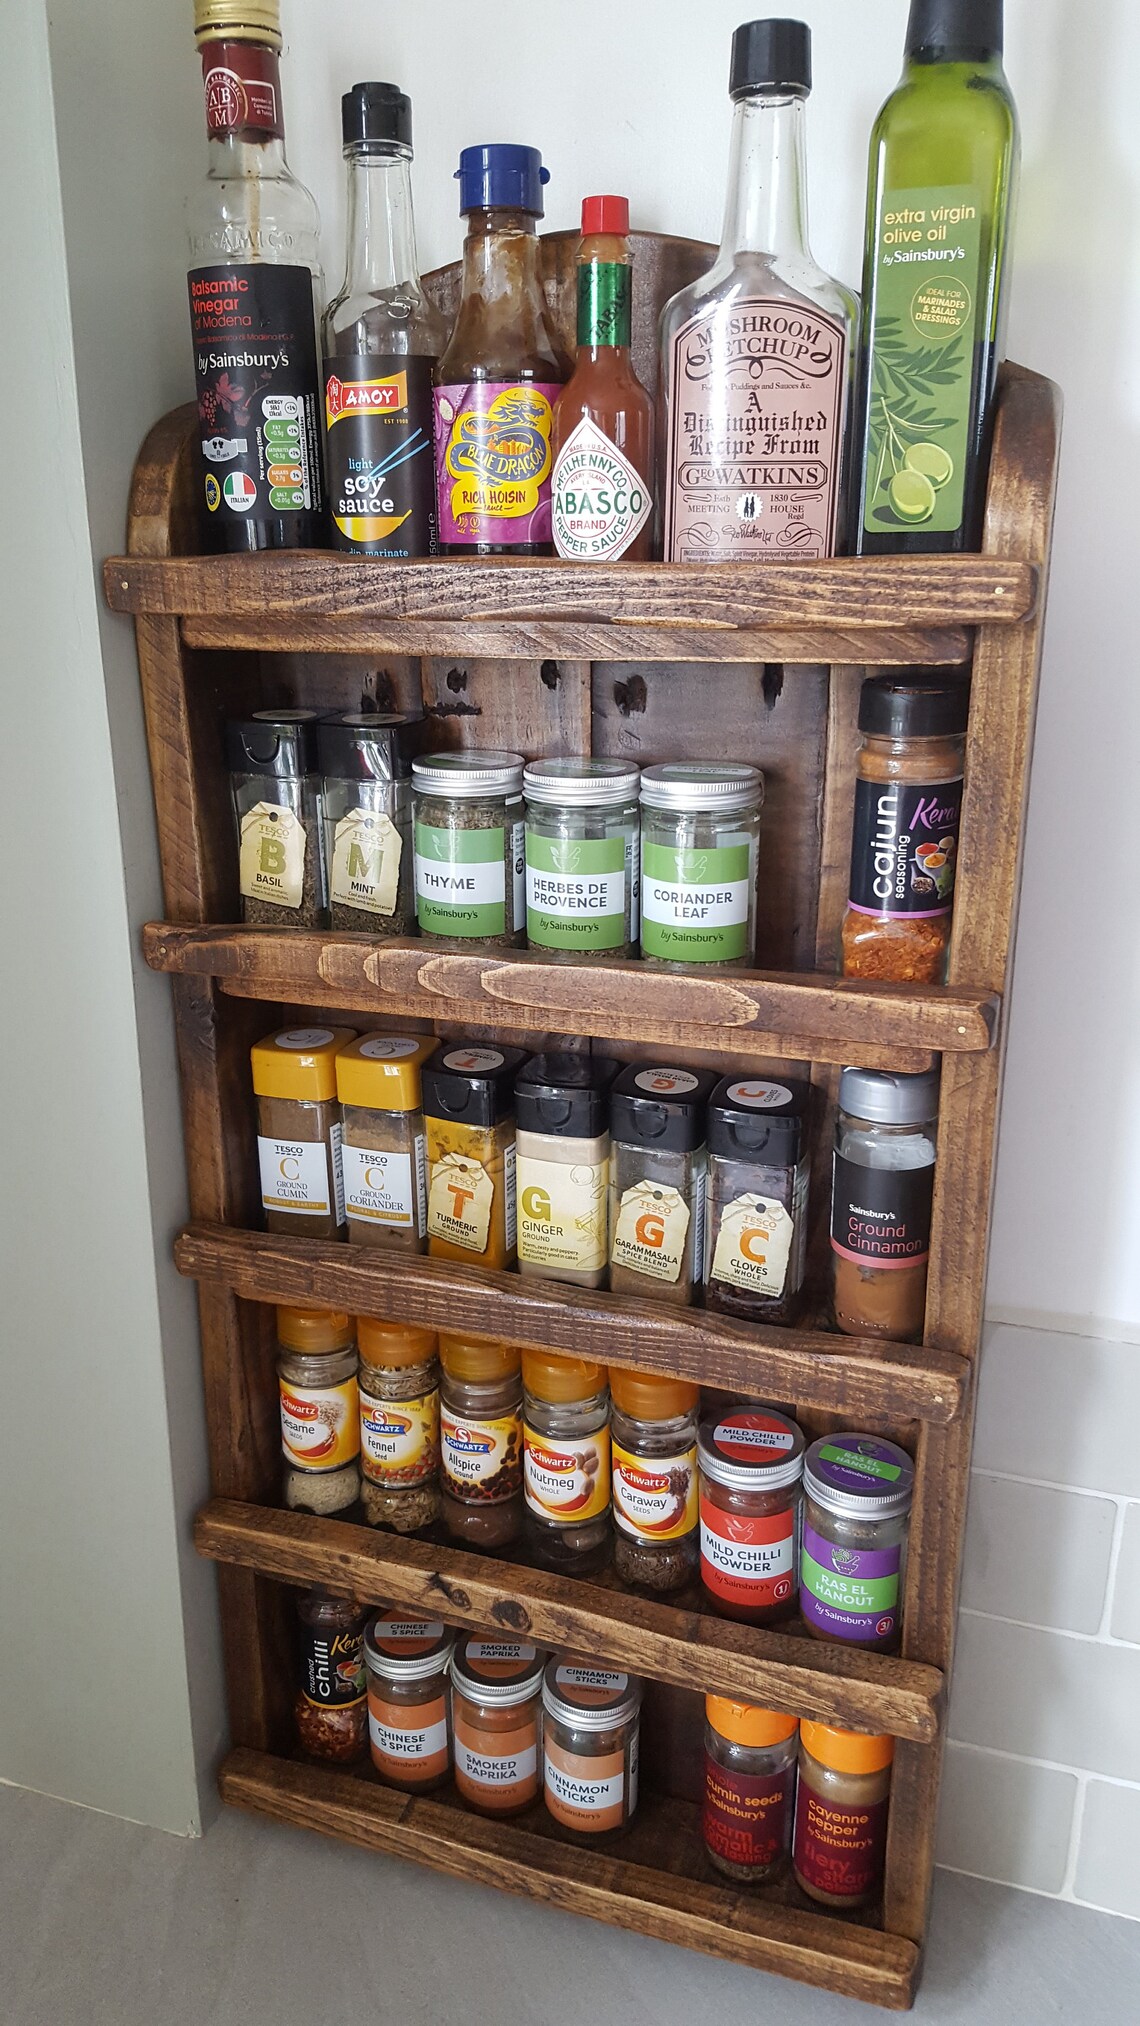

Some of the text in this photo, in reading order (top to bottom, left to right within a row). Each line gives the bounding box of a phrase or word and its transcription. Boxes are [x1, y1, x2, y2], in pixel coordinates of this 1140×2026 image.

[885, 204, 976, 225] extra virgin
[883, 225, 947, 245] olive oil
[883, 246, 966, 267] by Sainsbury's
[191, 276, 249, 297] Balsamic
[926, 287, 962, 299] IDEAL FOR
[193, 298, 239, 315] Vinegar
[918, 296, 966, 310] MARINADES
[923, 305, 958, 317] & SALAD
[203, 315, 252, 329] Modena
[915, 312, 962, 327] DRESSINGS
[696, 316, 822, 348] MSHROOM
[707, 337, 810, 364] ETCHUP
[198, 352, 289, 375] by Sainsbury's
[731, 382, 799, 391] Puddings and Sauces
[345, 389, 394, 406] AMOY
[744, 392, 763, 414] A
[684, 410, 828, 437] Disinguished
[761, 433, 820, 455] From
[349, 458, 374, 472] light
[468, 445, 546, 477] BLUE DRAGON
[345, 475, 386, 499] soy
[339, 498, 395, 513] sauce
[462, 490, 527, 505] RICH HOISIN
[770, 494, 789, 502] 1830
[688, 505, 805, 513] MEETING HOUSE
[788, 513, 805, 521] Regd
[570, 520, 607, 530] BRAND
[556, 516, 589, 554] PEPPER
[591, 516, 629, 552] SAUCE
[259, 823, 290, 838] TESCO
[353, 831, 385, 843] TESCO
[871, 795, 898, 899] cajun
[260, 837, 287, 876] B
[348, 843, 384, 884] M
[895, 835, 911, 900] seasoning
[256, 874, 284, 889] BASIL
[350, 882, 376, 896] MINT
[425, 872, 476, 890] THYME
[534, 877, 608, 896] HERBES DE
[534, 891, 608, 908] PROVENCE
[654, 888, 733, 905] CORIANDER
[424, 904, 479, 920] by Sainsbury's
[674, 906, 709, 919] LEAF
[540, 918, 600, 932] by Sainsbury's
[660, 929, 725, 944] by Sainsbury's
[274, 1145, 304, 1154] TESCO
[359, 1154, 388, 1164] TESCO
[279, 1158, 300, 1181] C
[276, 1181, 308, 1190] GROUND
[365, 1168, 385, 1191] C
[449, 1173, 478, 1187] TESCO
[277, 1189, 309, 1199] CUMIN
[360, 1190, 392, 1200] GROUND
[447, 1183, 475, 1220] T
[349, 1195, 404, 1211] CORIANDER
[522, 1186, 551, 1222] G
[640, 1200, 673, 1214] TESCO
[849, 1203, 896, 1221] Sainsbury's
[436, 1211, 478, 1234] TURMERIC
[442, 1222, 470, 1237] GROUND
[522, 1221, 564, 1237] GINGER
[743, 1214, 778, 1229] TESCO
[848, 1217, 906, 1238] Ground
[522, 1232, 550, 1243] GROUND
[635, 1214, 665, 1248] G
[615, 1238, 645, 1256] GARAM
[645, 1247, 679, 1265] MASALA
[739, 1228, 770, 1265] C
[848, 1233, 922, 1254] Cinnamon
[622, 1249, 643, 1262] SPICE
[644, 1256, 668, 1268] BLEND
[730, 1258, 769, 1276] CLOVES
[734, 1268, 762, 1281] WHOLE
[282, 1414, 316, 1435] Sesame
[364, 1419, 401, 1433] SCHWARTZ
[446, 1436, 485, 1451] SCHWARTZ
[723, 1428, 787, 1442] MILD CHILLI
[729, 1435, 777, 1446] POWDER
[367, 1436, 396, 1453] Fennel
[375, 1451, 388, 1461] Seed
[449, 1452, 482, 1473] Allspice
[530, 1448, 573, 1468] Schwartz
[836, 1455, 883, 1474] HANOUT
[844, 1452, 879, 1468] RAS EL
[454, 1468, 474, 1480] Ground
[530, 1466, 575, 1491] Nutmeg
[620, 1468, 667, 1488] Schwartz
[539, 1485, 560, 1496] WHOLE
[621, 1488, 667, 1510] Caraway
[633, 1505, 651, 1515] SEEDS
[706, 1534, 782, 1562] MILD CHILLI
[713, 1551, 772, 1572] POWDER
[714, 1573, 771, 1592] by Sainsbury's
[821, 1574, 869, 1595] RAS EL
[815, 1581, 875, 1607] HANOUT
[815, 1602, 873, 1627] by Sainsbury's
[480, 1644, 521, 1652] SMOKED
[307, 1658, 316, 1694] crushed
[314, 1640, 331, 1698] chilli
[566, 1668, 620, 1681] CINNAMON
[575, 1675, 608, 1686] STICKS
[378, 1727, 426, 1743] CHINESE
[381, 1738, 423, 1753] 5 SPICE
[466, 1754, 517, 1771] SMOKED
[466, 1764, 518, 1781] PAPRIKA
[548, 1766, 610, 1795] CINNAMON
[556, 1784, 596, 1804] STICKS
[706, 1774, 784, 1808] cumin seeds
[711, 1795, 767, 1822] Sainsbury's
[808, 1799, 869, 1824] cayenne
[808, 1810, 858, 1836] pepper
[814, 1830, 873, 1850] Sainsbury's
